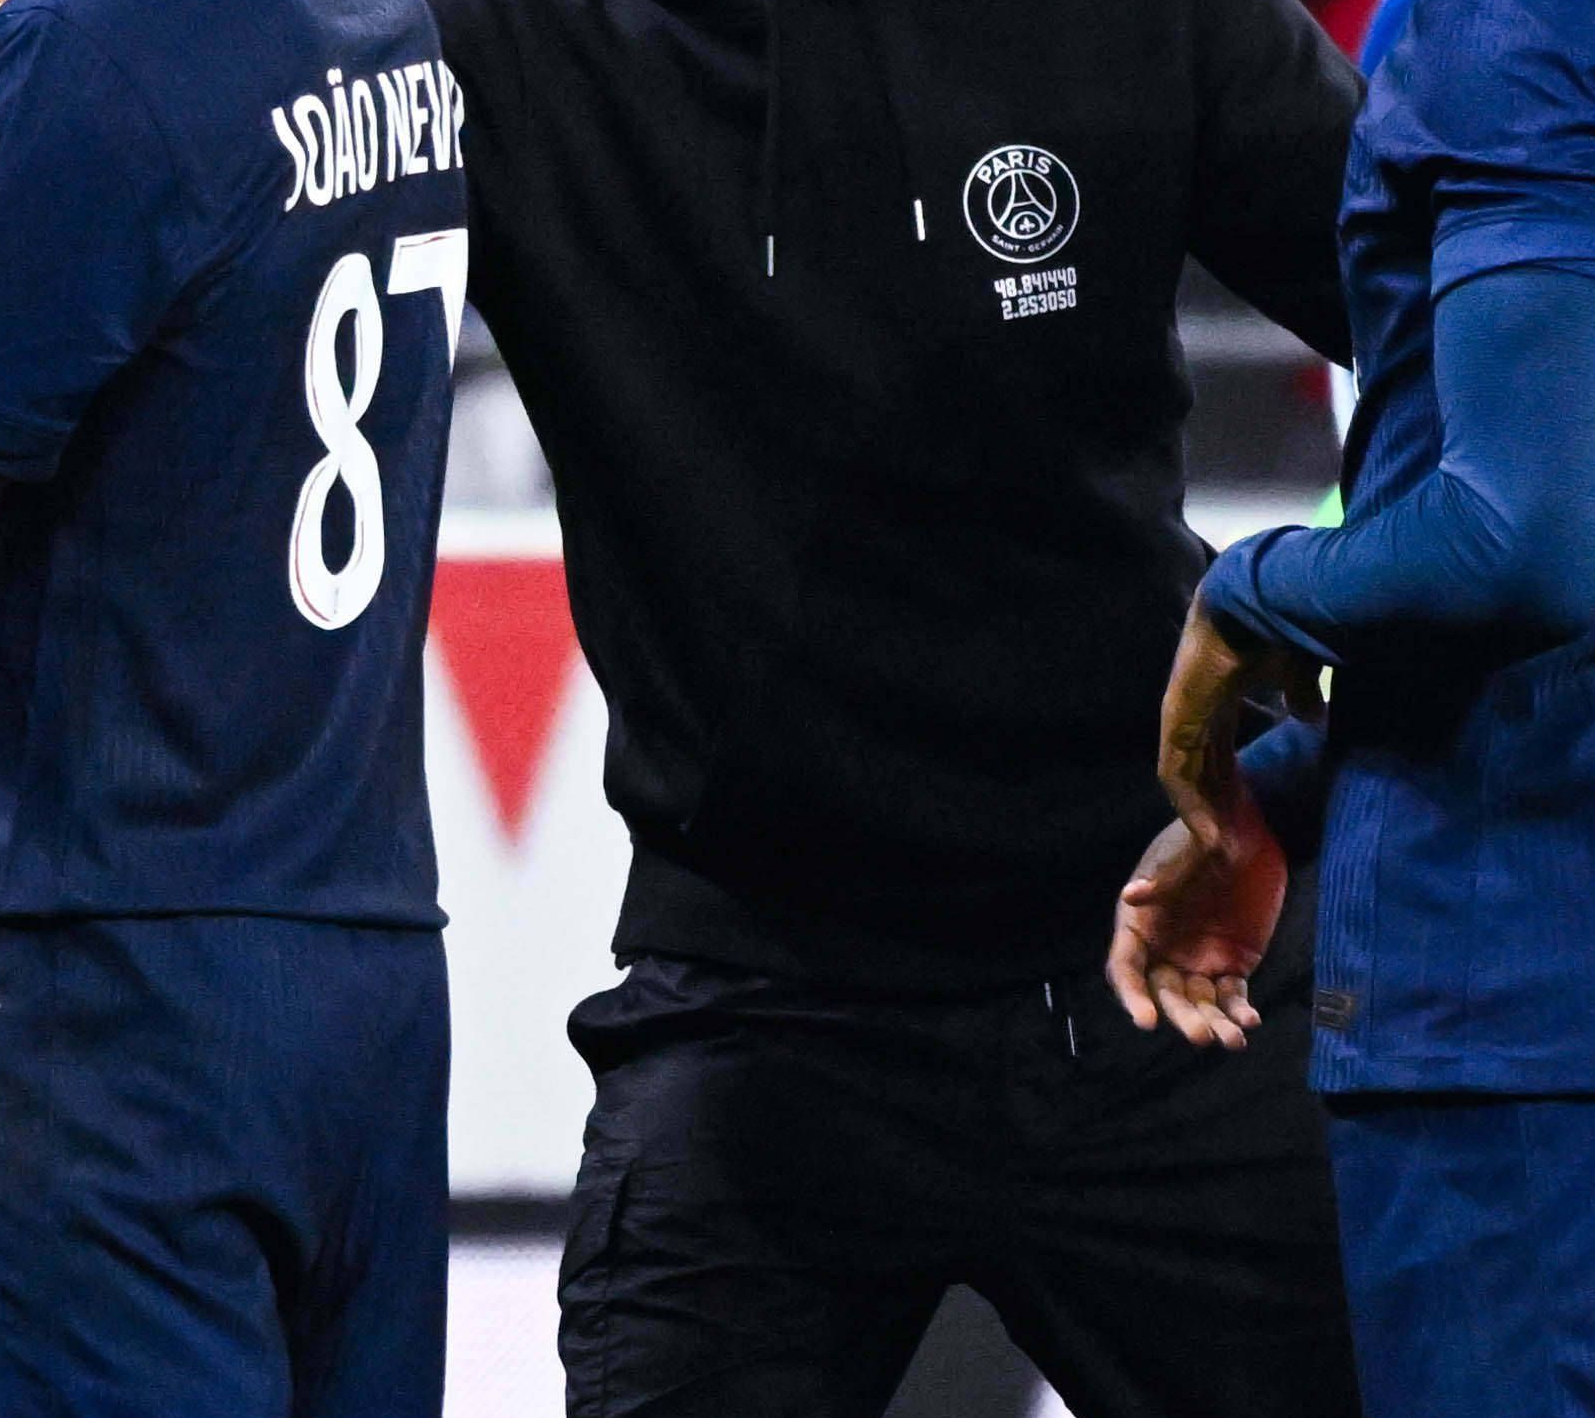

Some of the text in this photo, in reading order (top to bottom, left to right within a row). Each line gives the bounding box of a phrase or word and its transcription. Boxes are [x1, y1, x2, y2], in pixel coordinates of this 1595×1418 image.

[377, 59, 465, 183] NEV
[976, 150, 1053, 185] PARIS
[993, 266, 1077, 300] 48.841440
[1001, 287, 1077, 321] 2.253050
[288, 228, 469, 630] 87
